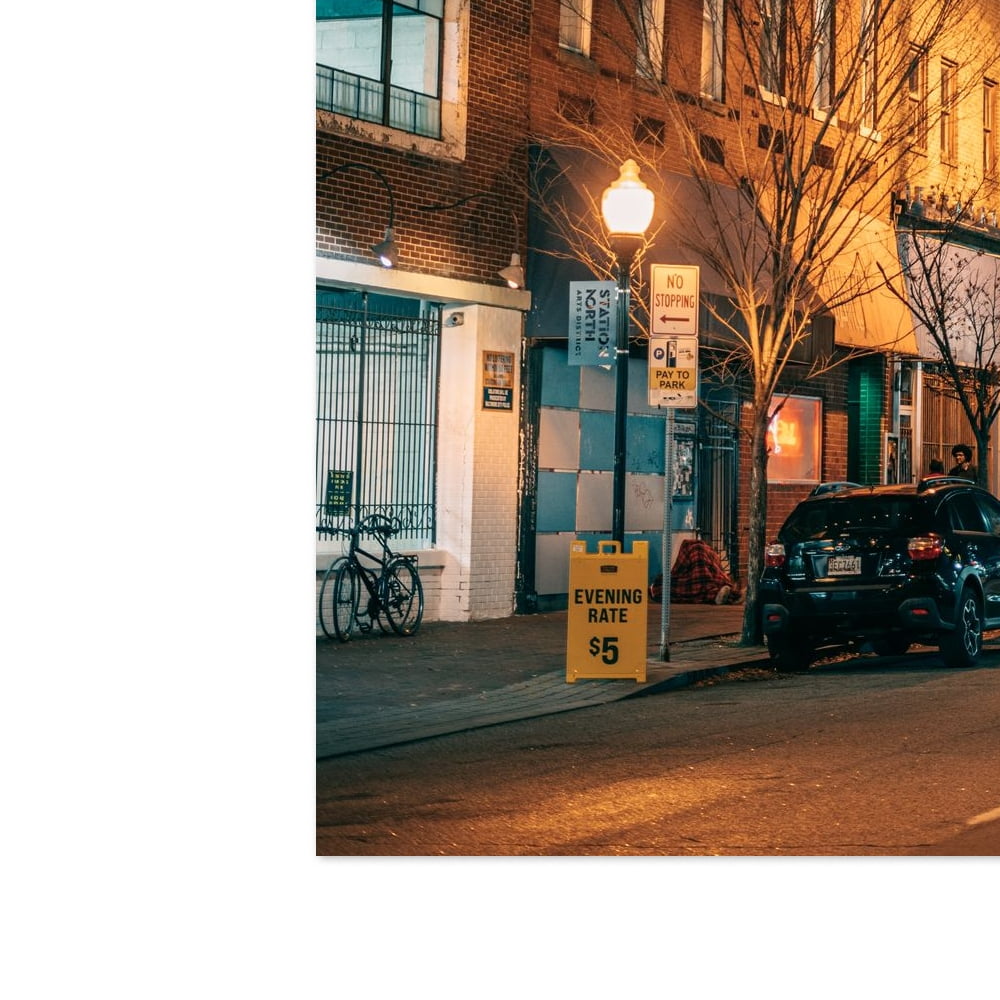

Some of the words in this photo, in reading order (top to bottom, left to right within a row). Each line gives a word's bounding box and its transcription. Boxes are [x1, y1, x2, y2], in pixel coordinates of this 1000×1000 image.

[667, 274, 683, 289] NO
[655, 293, 695, 309] STOPPING
[585, 289, 597, 342] NORTH
[598, 289, 610, 357] STATION
[656, 370, 674, 379] PAY
[676, 370, 690, 380] TO
[659, 380, 686, 390] PARK
[574, 588, 642, 604] EVENING
[588, 608, 628, 623] RATE
[589, 636, 619, 665] $5
